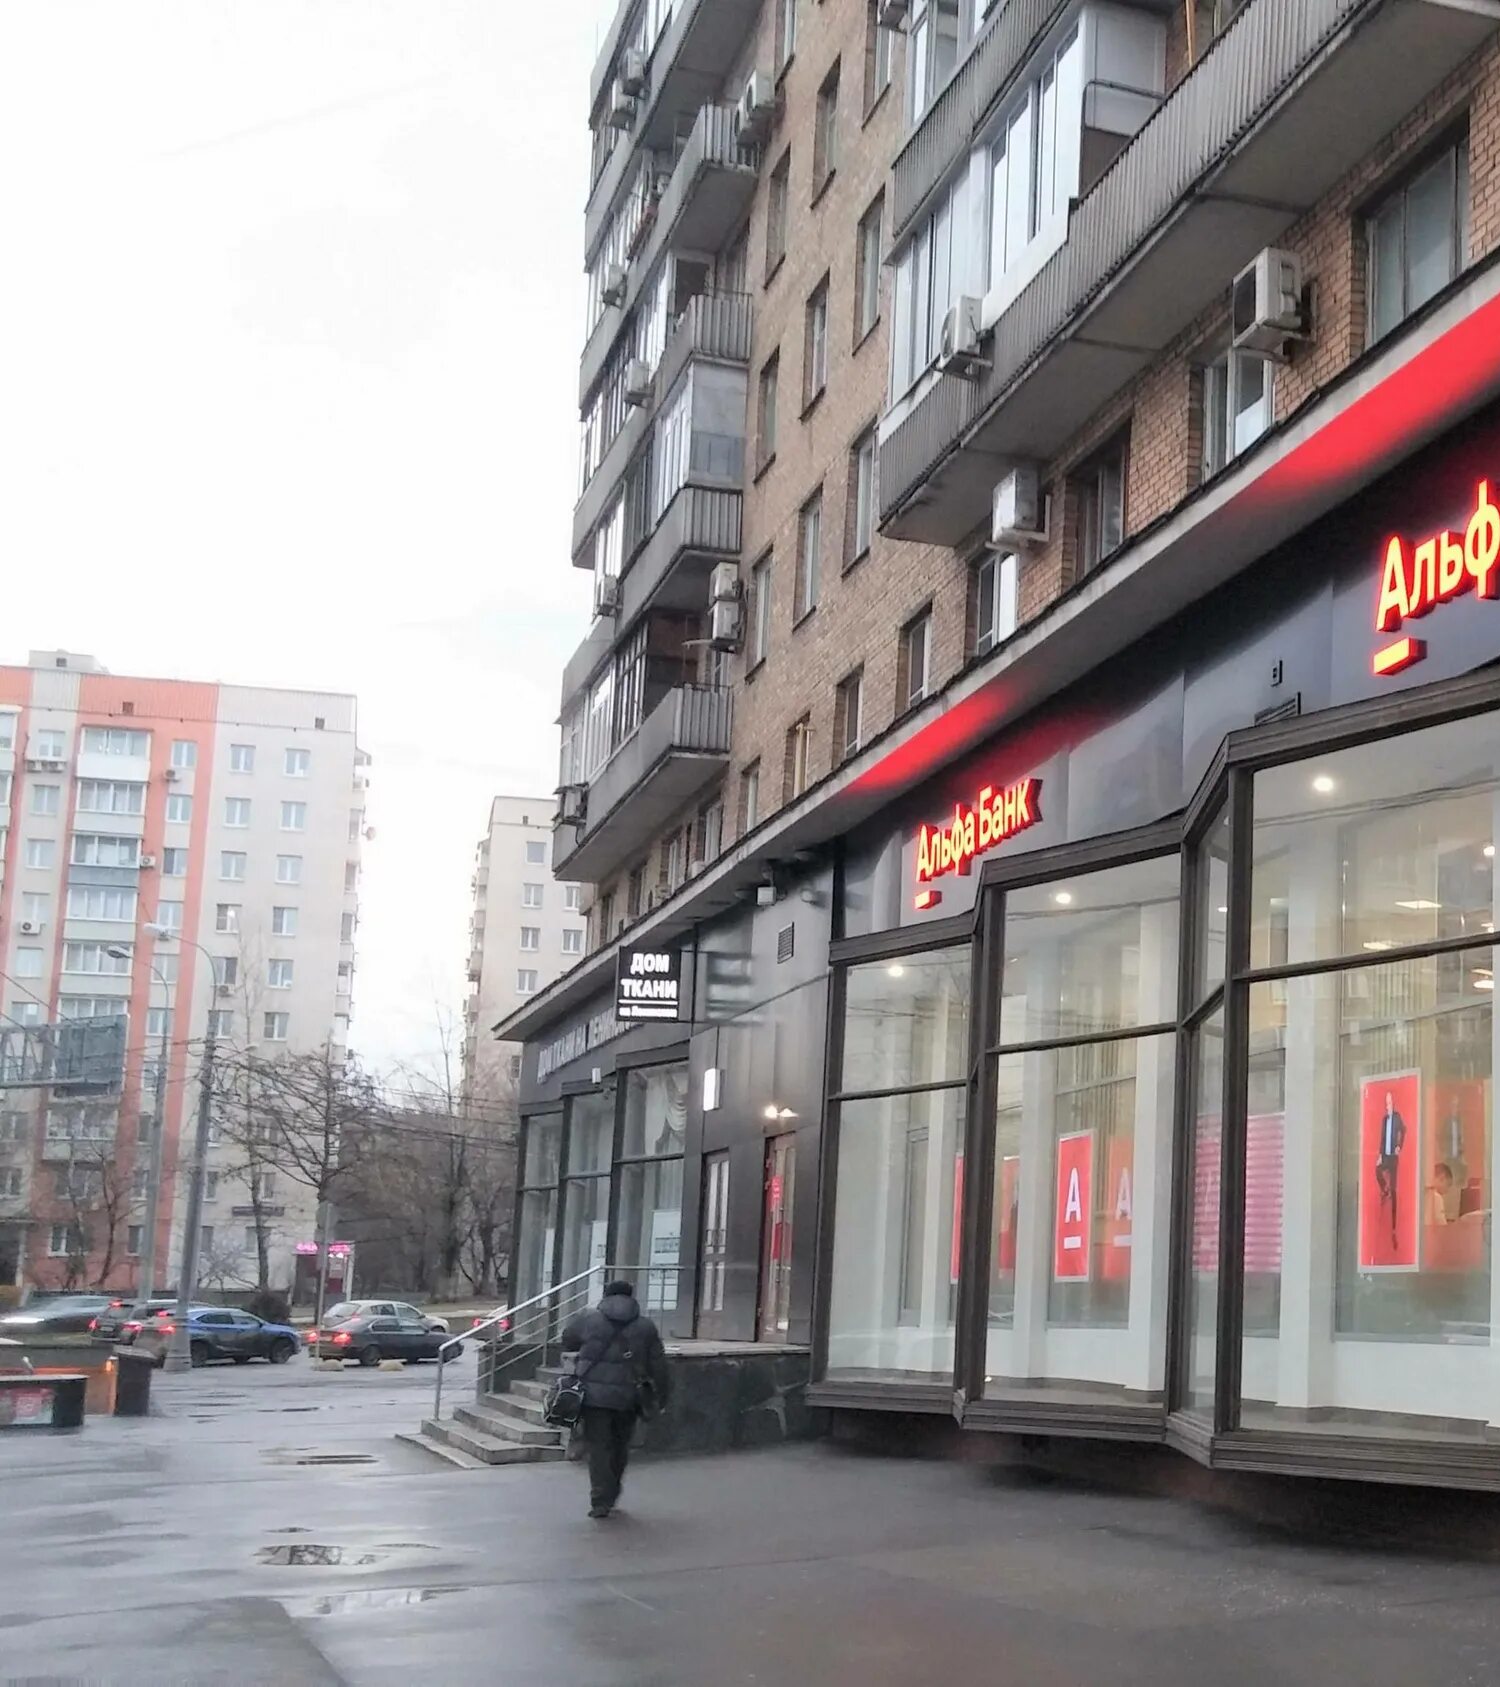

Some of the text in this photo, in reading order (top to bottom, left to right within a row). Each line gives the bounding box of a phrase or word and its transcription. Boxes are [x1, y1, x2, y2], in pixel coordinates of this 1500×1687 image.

[916, 778, 1039, 881] Альфа Банк
[630, 953, 670, 975] ДОМ
[621, 978, 677, 999] ТКАНИ
